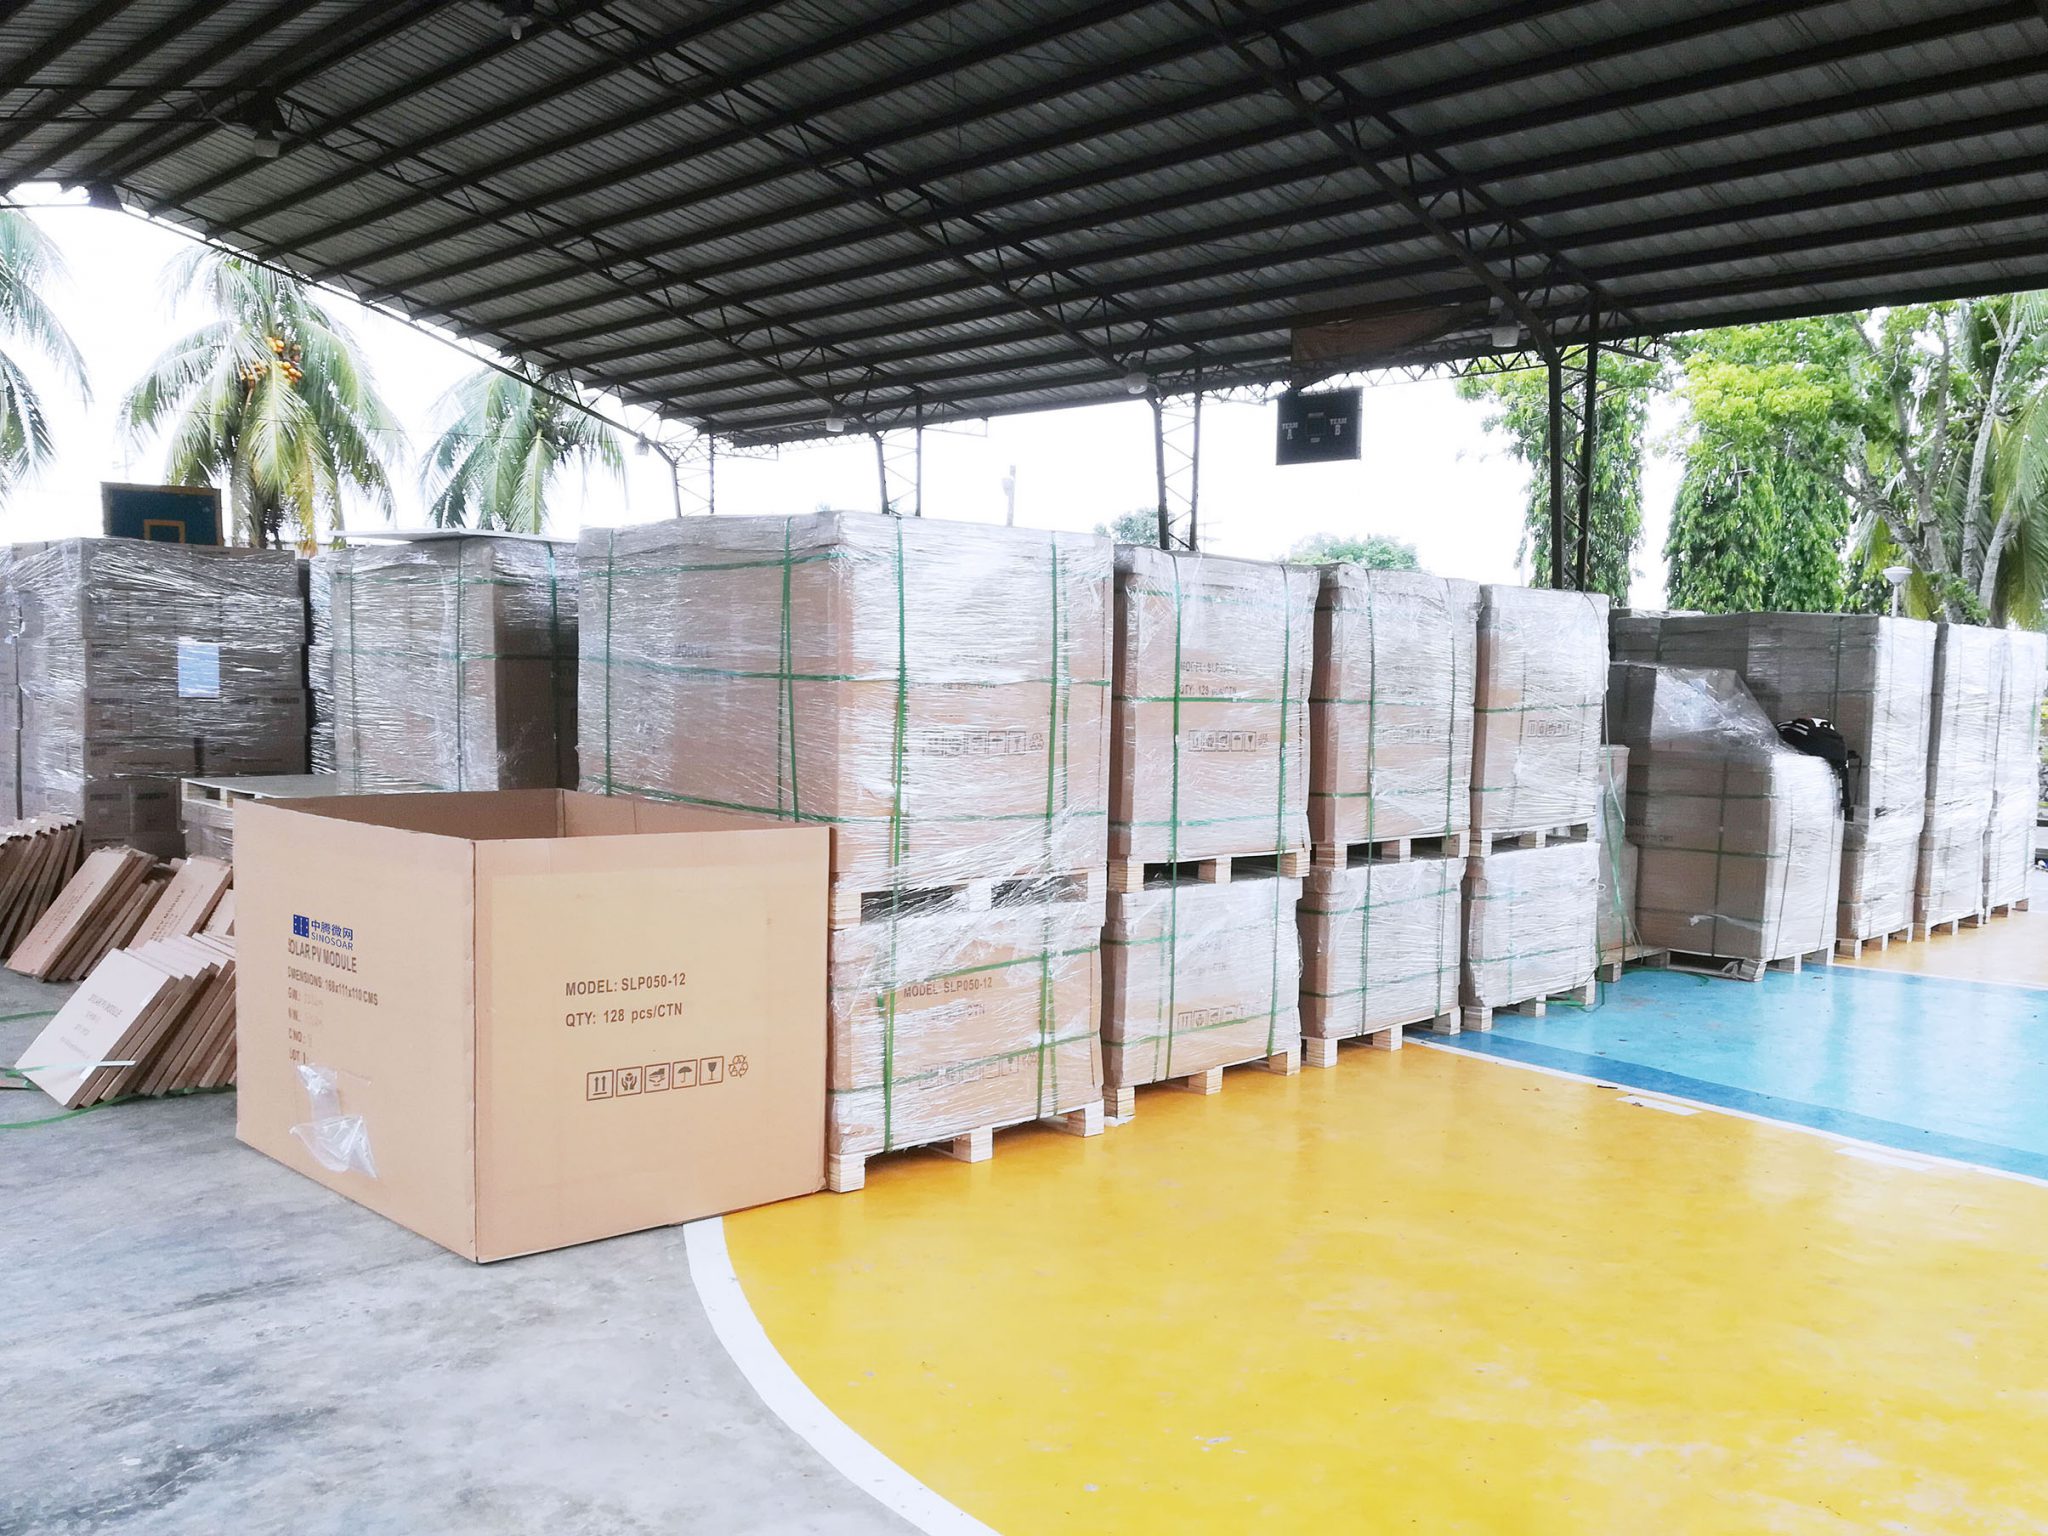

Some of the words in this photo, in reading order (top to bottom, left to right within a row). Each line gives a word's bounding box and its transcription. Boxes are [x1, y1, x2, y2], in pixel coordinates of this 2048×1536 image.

[311, 919, 353, 941] 中腾微网
[311, 932, 353, 951] SINOSOAR
[311, 945, 322, 962] PV
[323, 948, 357, 973] MODULE
[566, 980, 618, 996] MODEL:
[621, 972, 686, 992] SLP050-12
[943, 976, 993, 993] SLP050-12
[363, 990, 379, 1006] CMS
[565, 1011, 596, 1027] QTY:
[603, 1008, 625, 1024] 128
[631, 1002, 683, 1024] pcs/CTN
